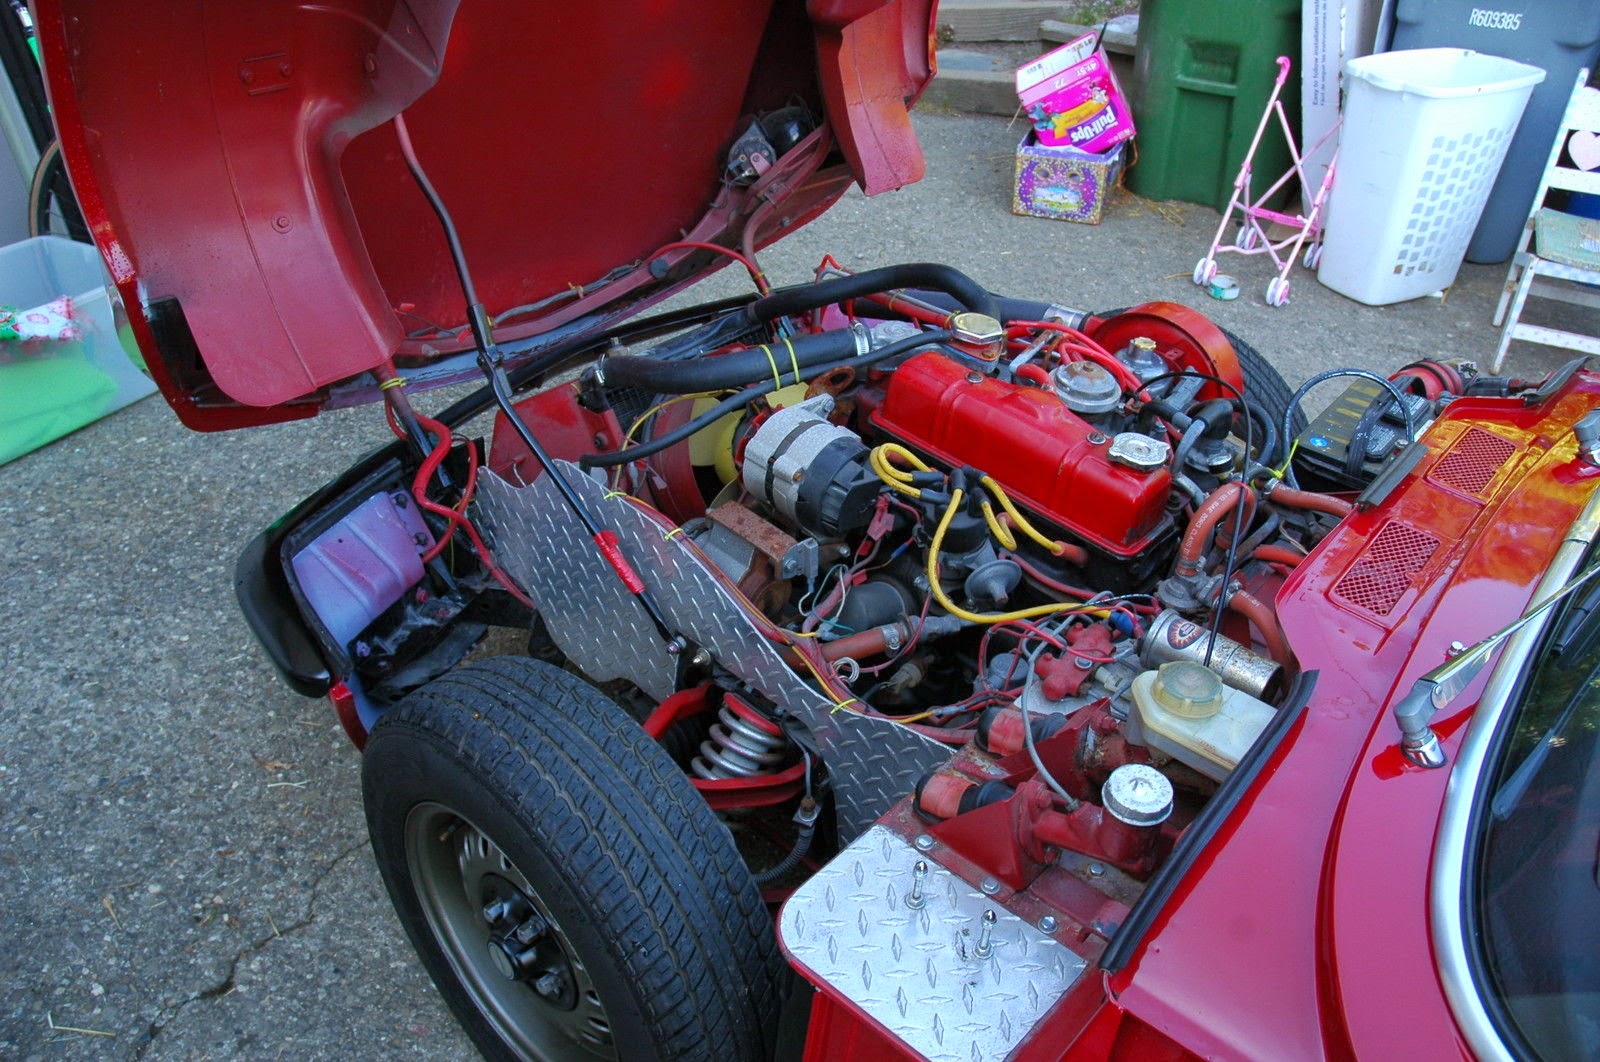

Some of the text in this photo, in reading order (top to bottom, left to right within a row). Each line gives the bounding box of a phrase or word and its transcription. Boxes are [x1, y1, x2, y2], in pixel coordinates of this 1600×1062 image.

[1468, 8, 1523, 31] R609385
[1053, 78, 1066, 89] 72
[1070, 105, 1116, 142] Pull-Ups
